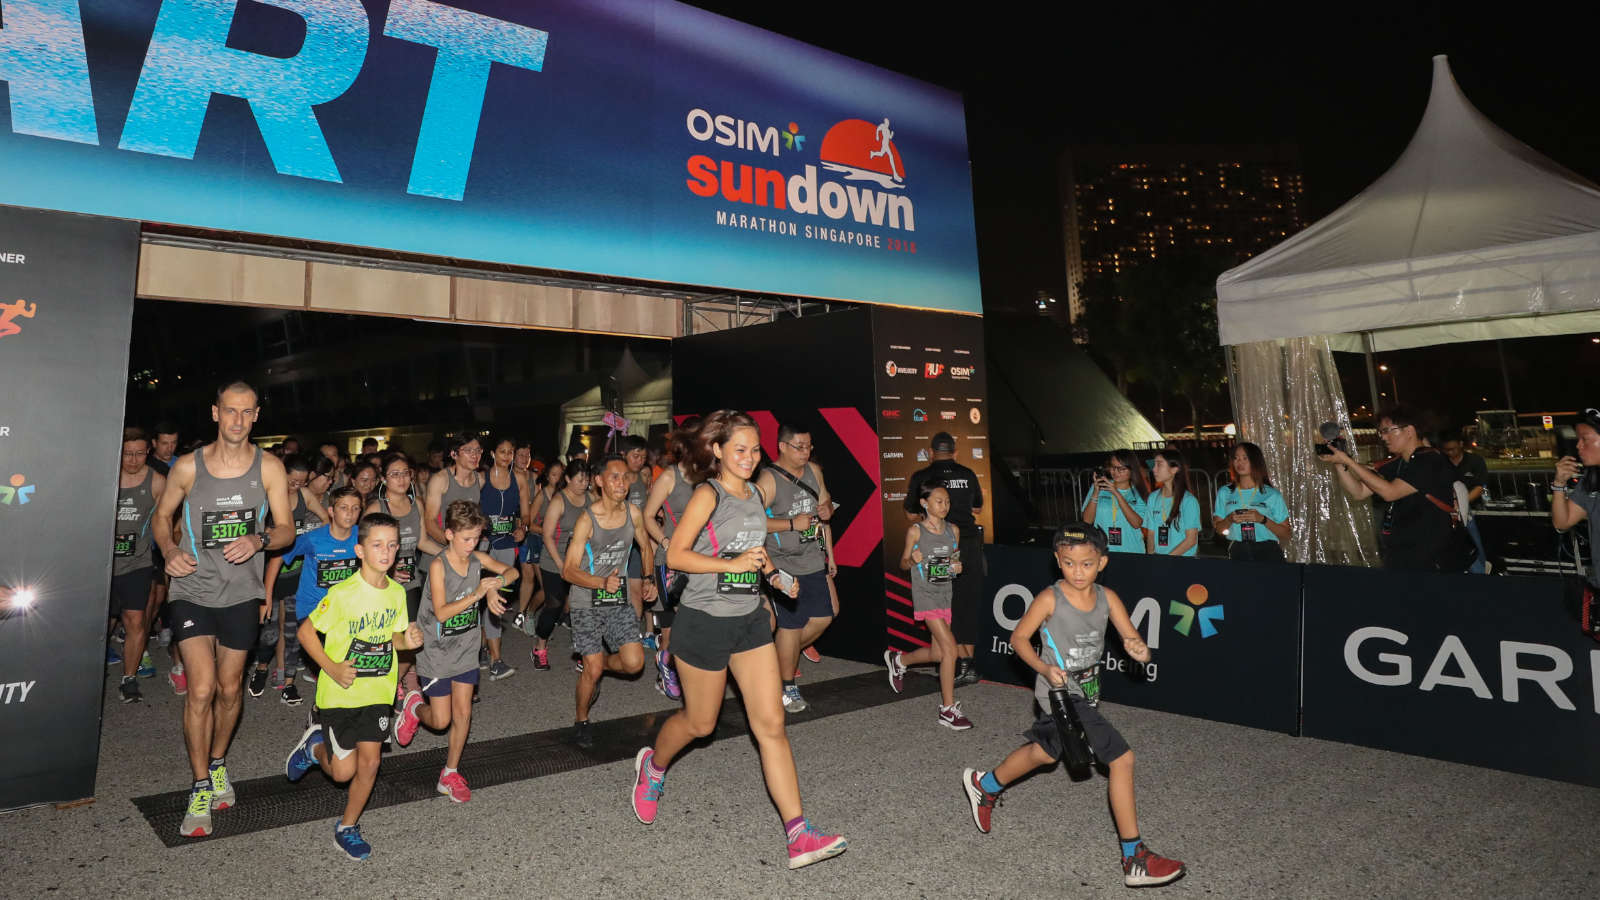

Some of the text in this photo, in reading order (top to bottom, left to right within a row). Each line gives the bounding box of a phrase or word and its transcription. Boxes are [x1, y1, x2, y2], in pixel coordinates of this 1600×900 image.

[686, 108, 780, 157] OSIM
[686, 154, 915, 232] sundown
[716, 210, 797, 237] MARATHON
[805, 225, 881, 249] SINGAPORE
[950, 366, 971, 377] OSIM
[211, 522, 248, 539] 53176
[321, 568, 353, 582] 50749
